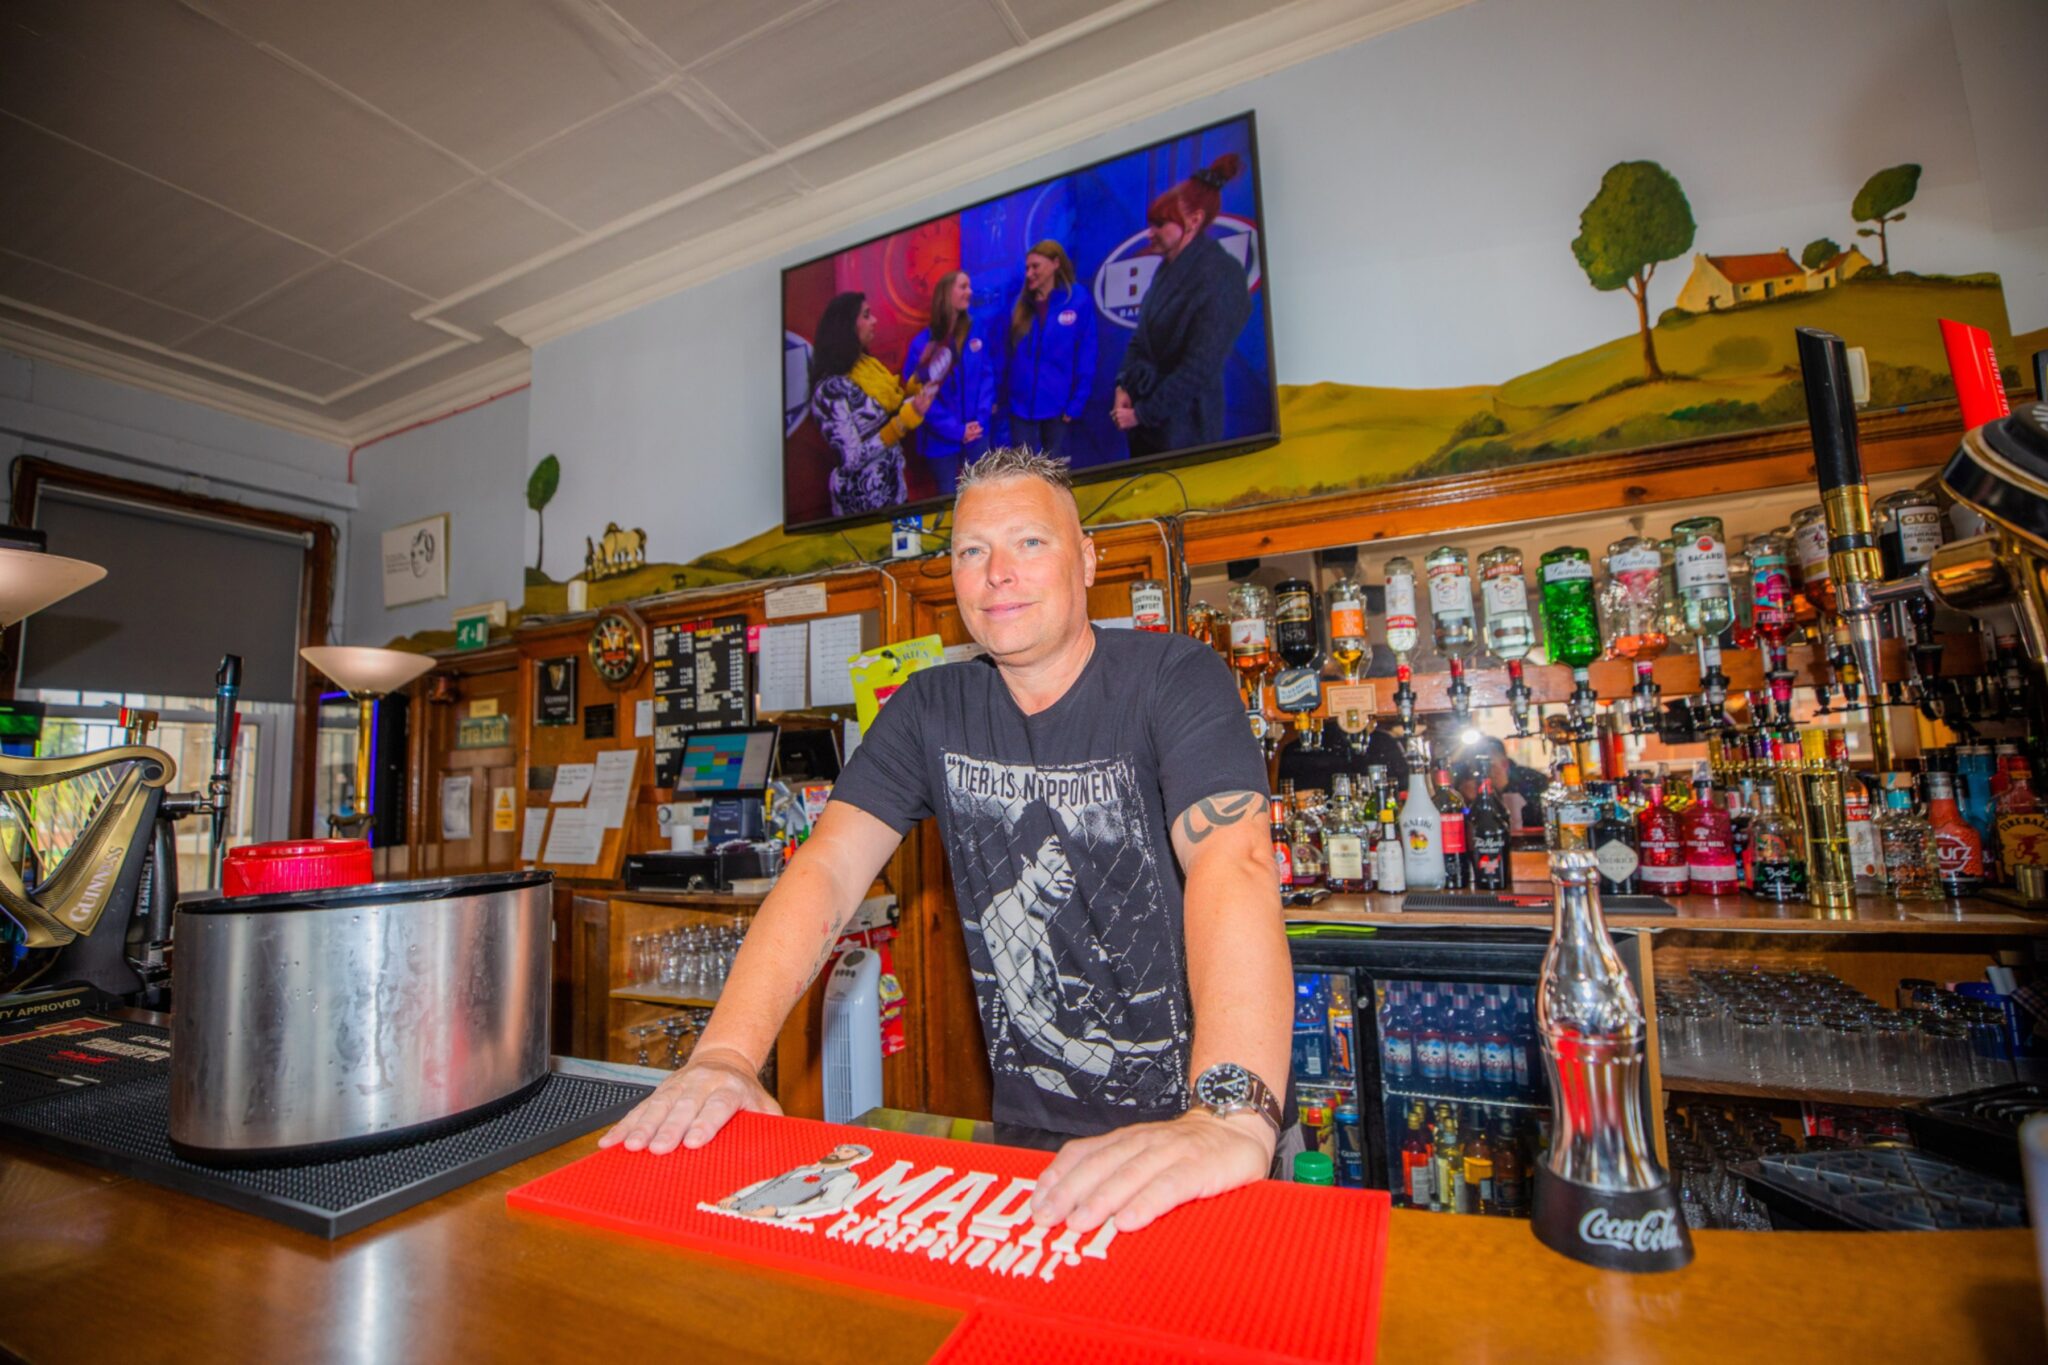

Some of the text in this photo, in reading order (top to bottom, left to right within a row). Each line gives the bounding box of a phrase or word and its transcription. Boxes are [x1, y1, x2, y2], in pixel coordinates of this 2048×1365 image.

[1904, 513, 1936, 523] OVD
[1688, 552, 1724, 563] BACARDI
[481, 720, 506, 744] Exit
[1001, 771, 1016, 799] IS
[1937, 846, 1974, 861] urz
[69, 846, 125, 923] GUINNESS
[17, 998, 81, 1018] APPROVED
[845, 1159, 1119, 1262] MAD
[1578, 1206, 1683, 1253] Coca-Cola
